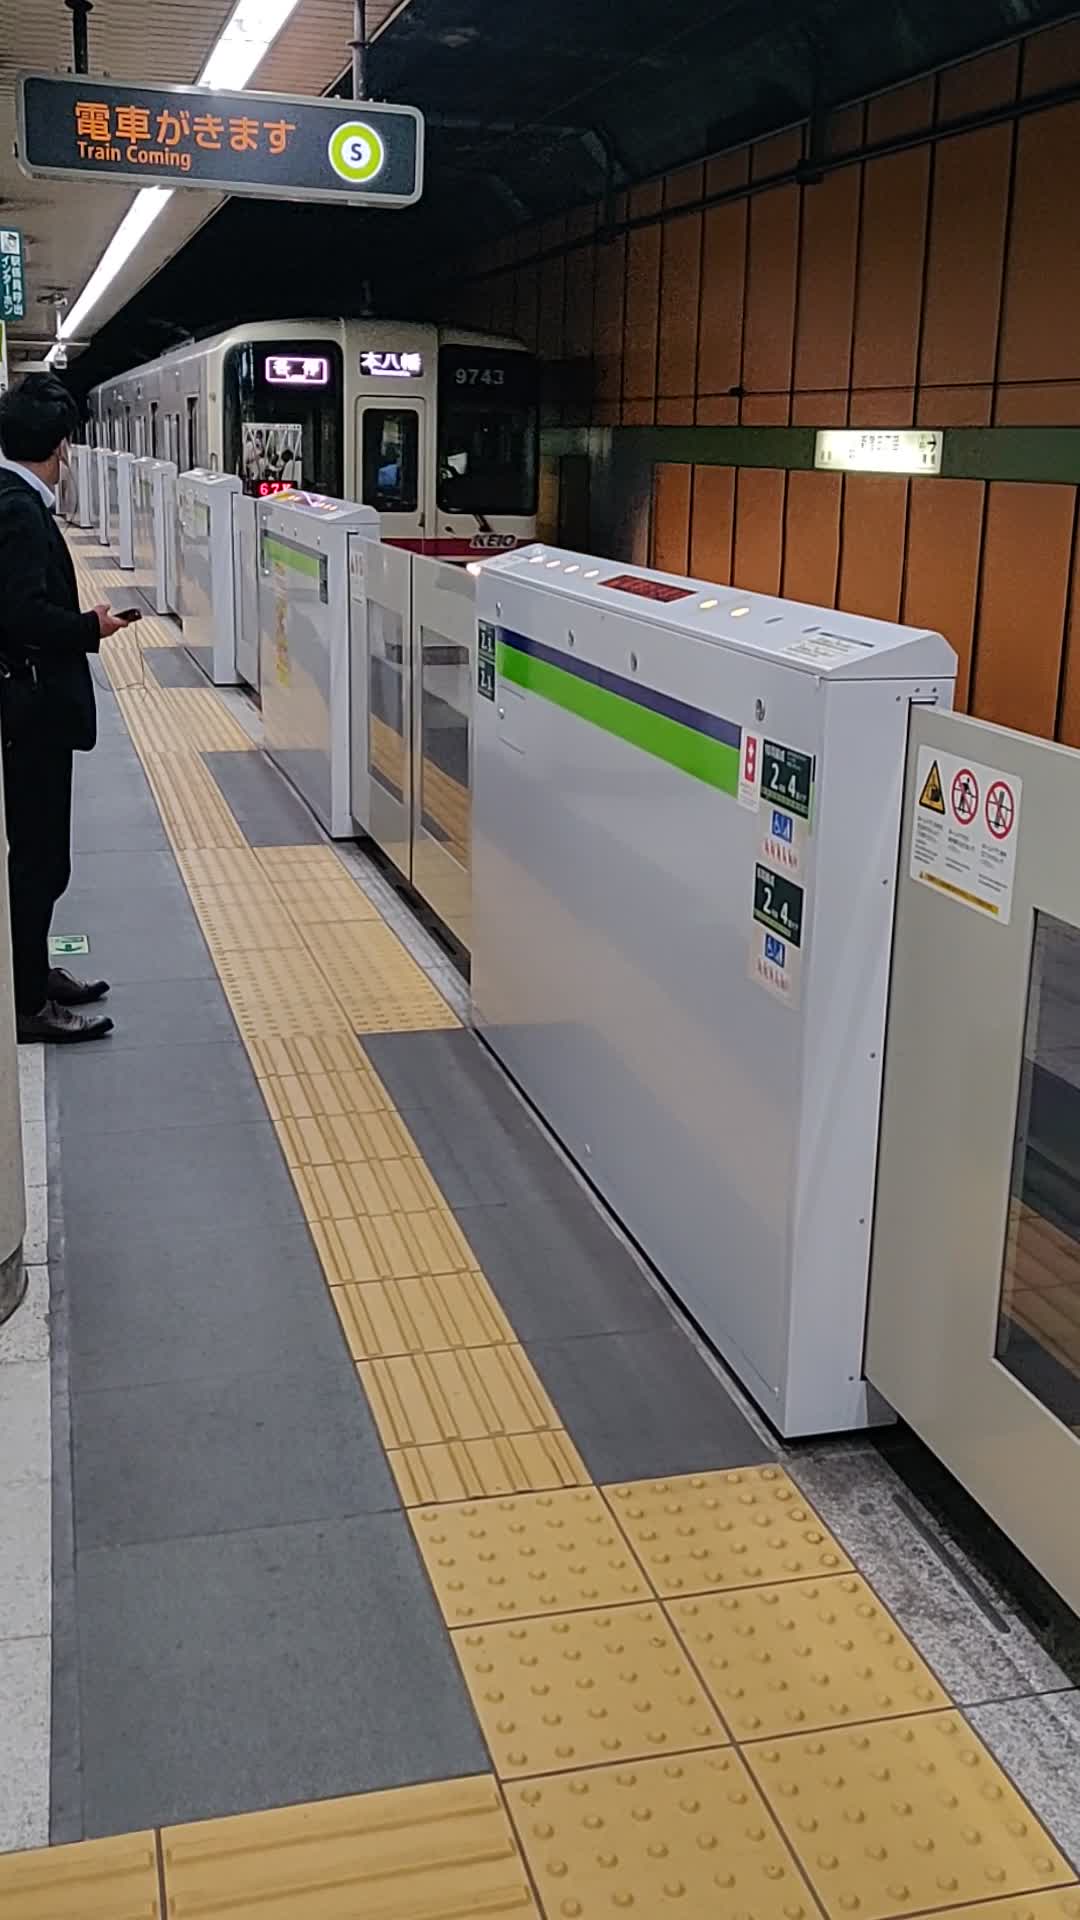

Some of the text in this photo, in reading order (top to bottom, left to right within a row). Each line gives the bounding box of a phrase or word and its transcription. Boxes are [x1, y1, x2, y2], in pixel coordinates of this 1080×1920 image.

[75, 101, 296, 155] 電車がきます
[77, 141, 191, 172] Train Coming
[350, 142, 363, 162] S
[360, 351, 422, 371] 本八幡
[455, 368, 505, 385] 9743
[473, 534, 515, 547] KEIO
